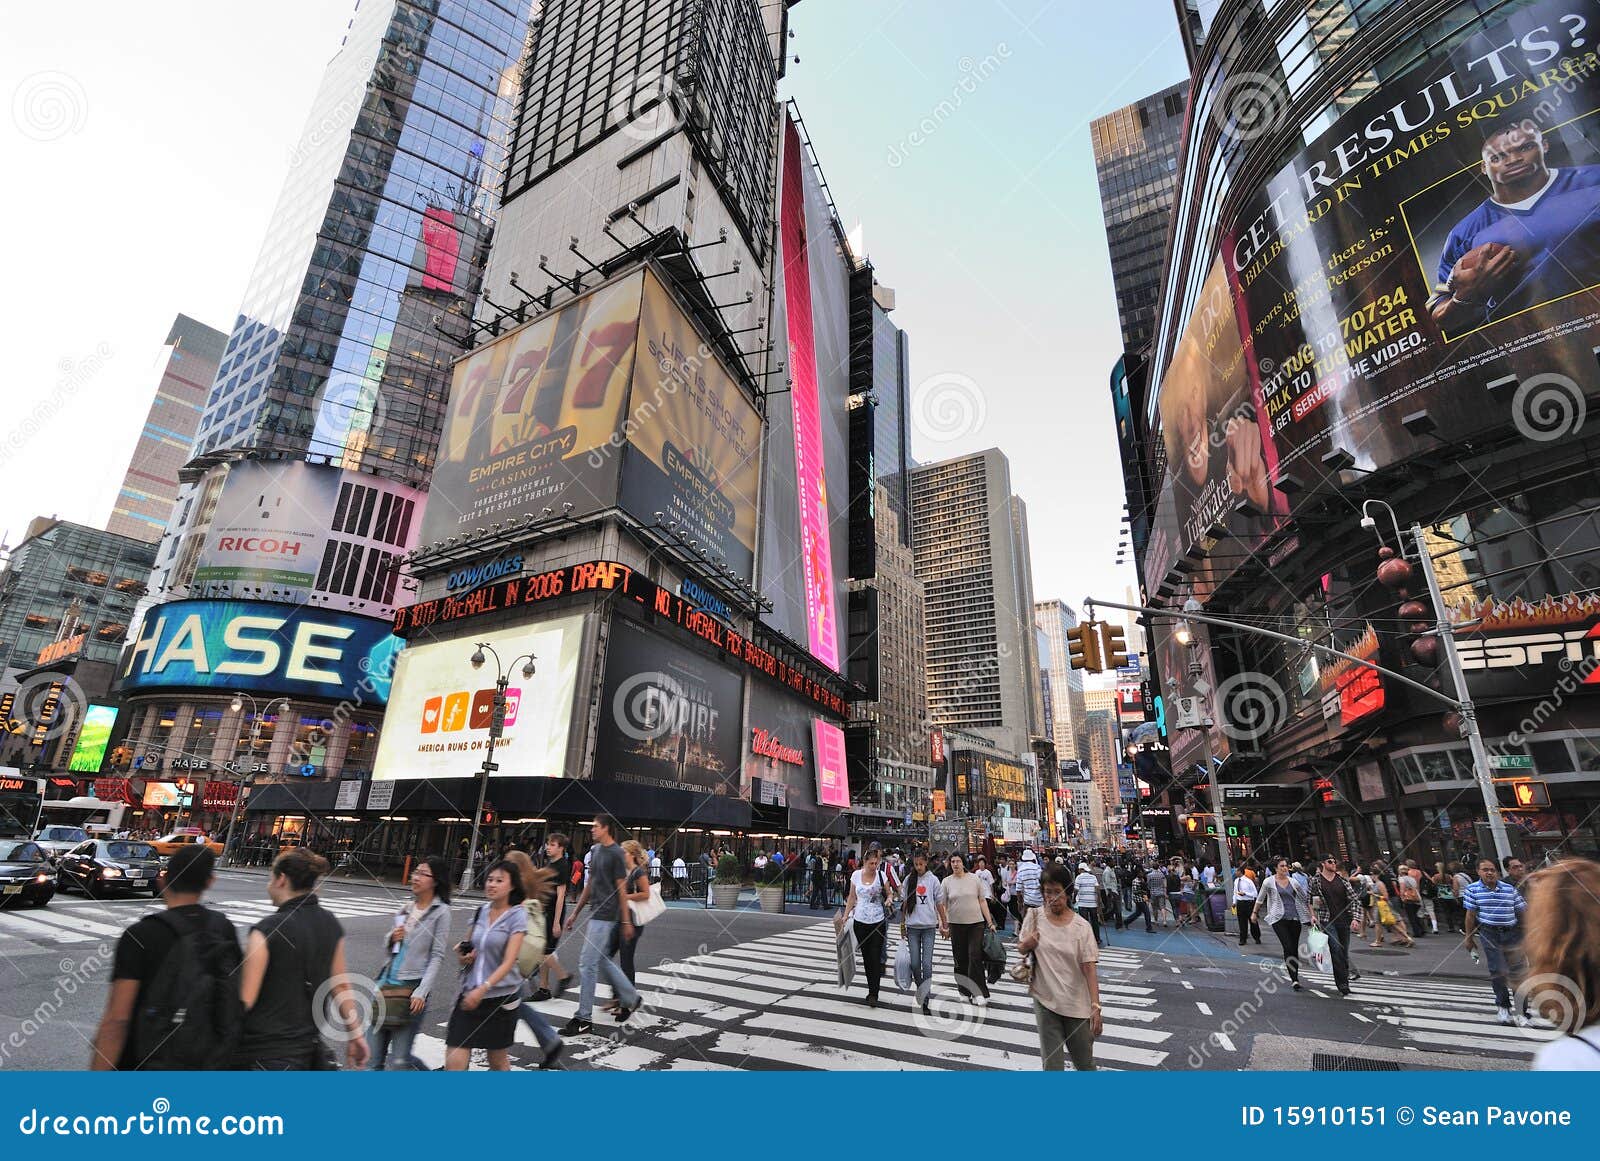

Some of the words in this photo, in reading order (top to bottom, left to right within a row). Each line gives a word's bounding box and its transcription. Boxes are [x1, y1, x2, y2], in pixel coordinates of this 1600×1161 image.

[1233, 187, 1290, 272] GET
[1300, 14, 1587, 203] RESULTS?
[1245, 198, 1332, 287] BILLBOARD
[1335, 174, 1362, 204] IN
[1366, 122, 1451, 180] TIMES
[1255, 302, 1283, 335] sports
[1327, 237, 1366, 270] there
[1326, 243, 1394, 290] Peterson
[1261, 372, 1283, 402] TEXT
[1283, 344, 1316, 378] TUG
[1317, 332, 1337, 353] TO
[1339, 286, 1408, 339] 70734
[1263, 385, 1292, 421] TALK
[1292, 371, 1311, 395] TO
[1313, 308, 1417, 379] TUGWATER
[1276, 409, 1293, 431] GET
[1295, 378, 1337, 417] SERVED
[1343, 358, 1371, 383] THE
[1371, 331, 1427, 366] VIDEO.
[468, 451, 527, 483] EMPIRE
[530, 433, 570, 460] CITY
[491, 465, 537, 490] CASINO
[457, 511, 476, 524] EXIT
[496, 495, 522, 512] STATE
[525, 481, 566, 502] THRUWAY
[473, 488, 509, 509] YONKERS
[511, 476, 551, 497] RACEWAY
[667, 449, 709, 499] EMPIRE
[710, 491, 734, 521] CITY
[685, 489, 715, 521] CASINO
[800, 477, 808, 518] RUNS
[1184, 471, 1234, 545] Tugwater
[218, 537, 301, 556] RICOH
[124, 614, 355, 685] HASE
[411, 600, 437, 627] 10TH
[442, 586, 497, 620] OVERALL
[505, 580, 521, 608] IN
[525, 569, 565, 602] 2006
[571, 561, 632, 593] DRAFT
[655, 586, 671, 618] NO.
[677, 600, 683, 625] 1
[686, 606, 723, 648] OVERALL
[726, 629, 743, 659] PICK
[744, 640, 777, 677] BRADFORD
[778, 661, 786, 683] TO
[787, 666, 804, 693] START
[32, 725, 48, 745] NEW
[41, 680, 62, 721] VICTORY
[478, 704, 489, 714] ON
[644, 684, 720, 743] EMPIRE
[1143, 681, 1153, 712] 1500
[171, 758, 208, 769] CHASE
[224, 761, 268, 772] CHSE
[417, 743, 446, 753] AMERICA
[447, 741, 468, 752] RUNS
[470, 740, 483, 751] ON
[485, 737, 513, 750] DNKIN'
[752, 727, 805, 769] Walgreens
[1511, 757, 1521, 767] 42
[1226, 789, 1260, 798] ESPN
